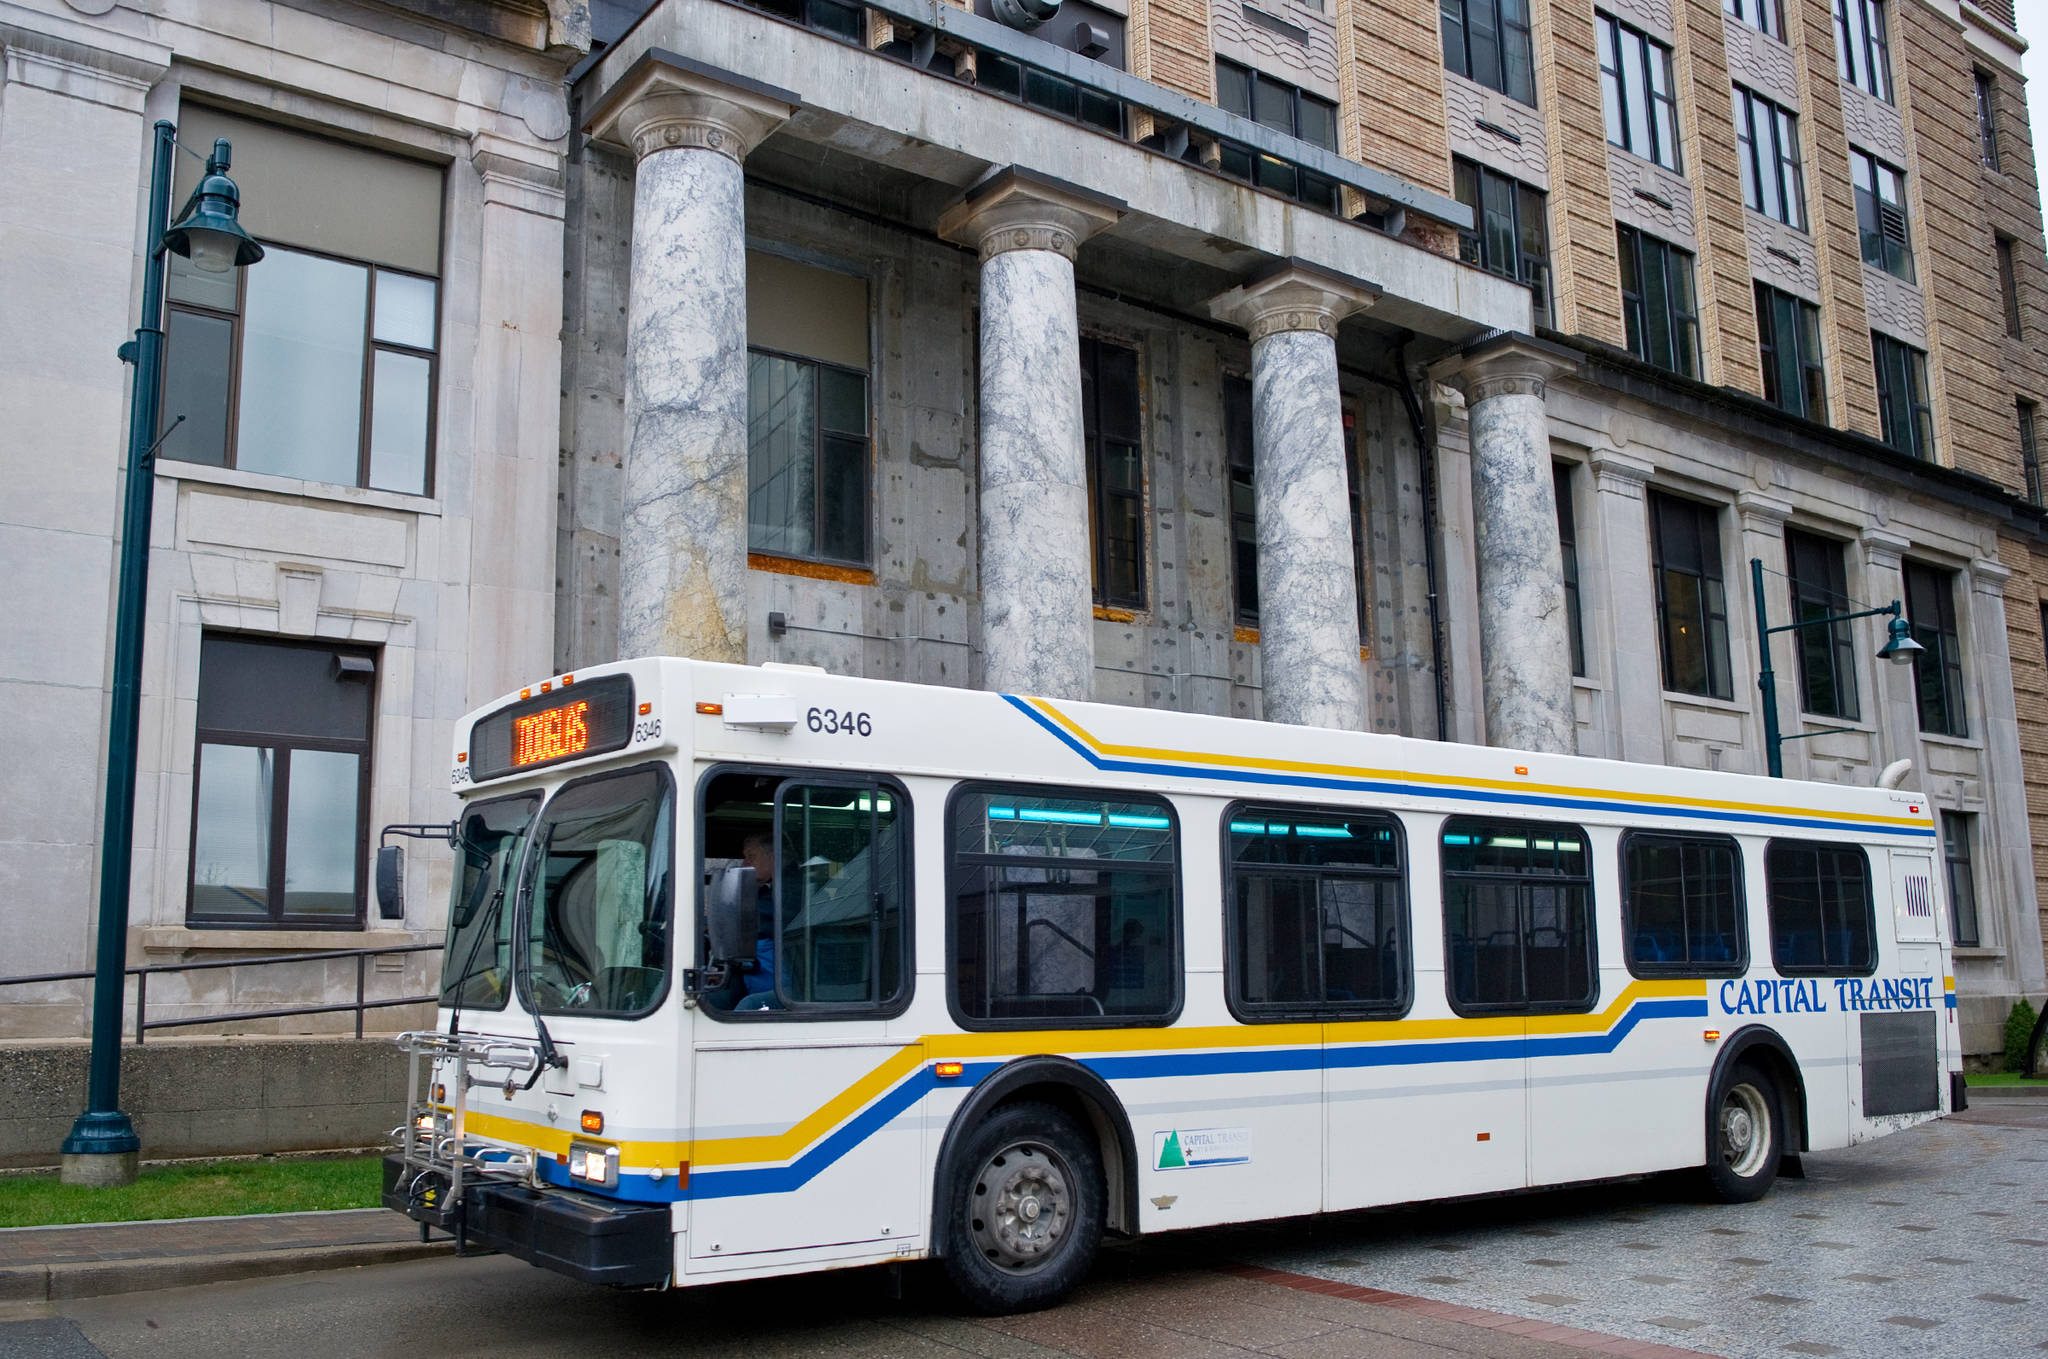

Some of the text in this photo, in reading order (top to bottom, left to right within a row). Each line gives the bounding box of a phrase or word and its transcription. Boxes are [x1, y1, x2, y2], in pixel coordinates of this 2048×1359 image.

[518, 701, 589, 766] DOUGLAS
[635, 718, 662, 743] 6346
[807, 707, 872, 737] 6346
[451, 766, 470, 785] 6346
[1720, 976, 1933, 1015] CAPITAL TRANSIT
[1184, 1134, 1215, 1146] CAPITAL
